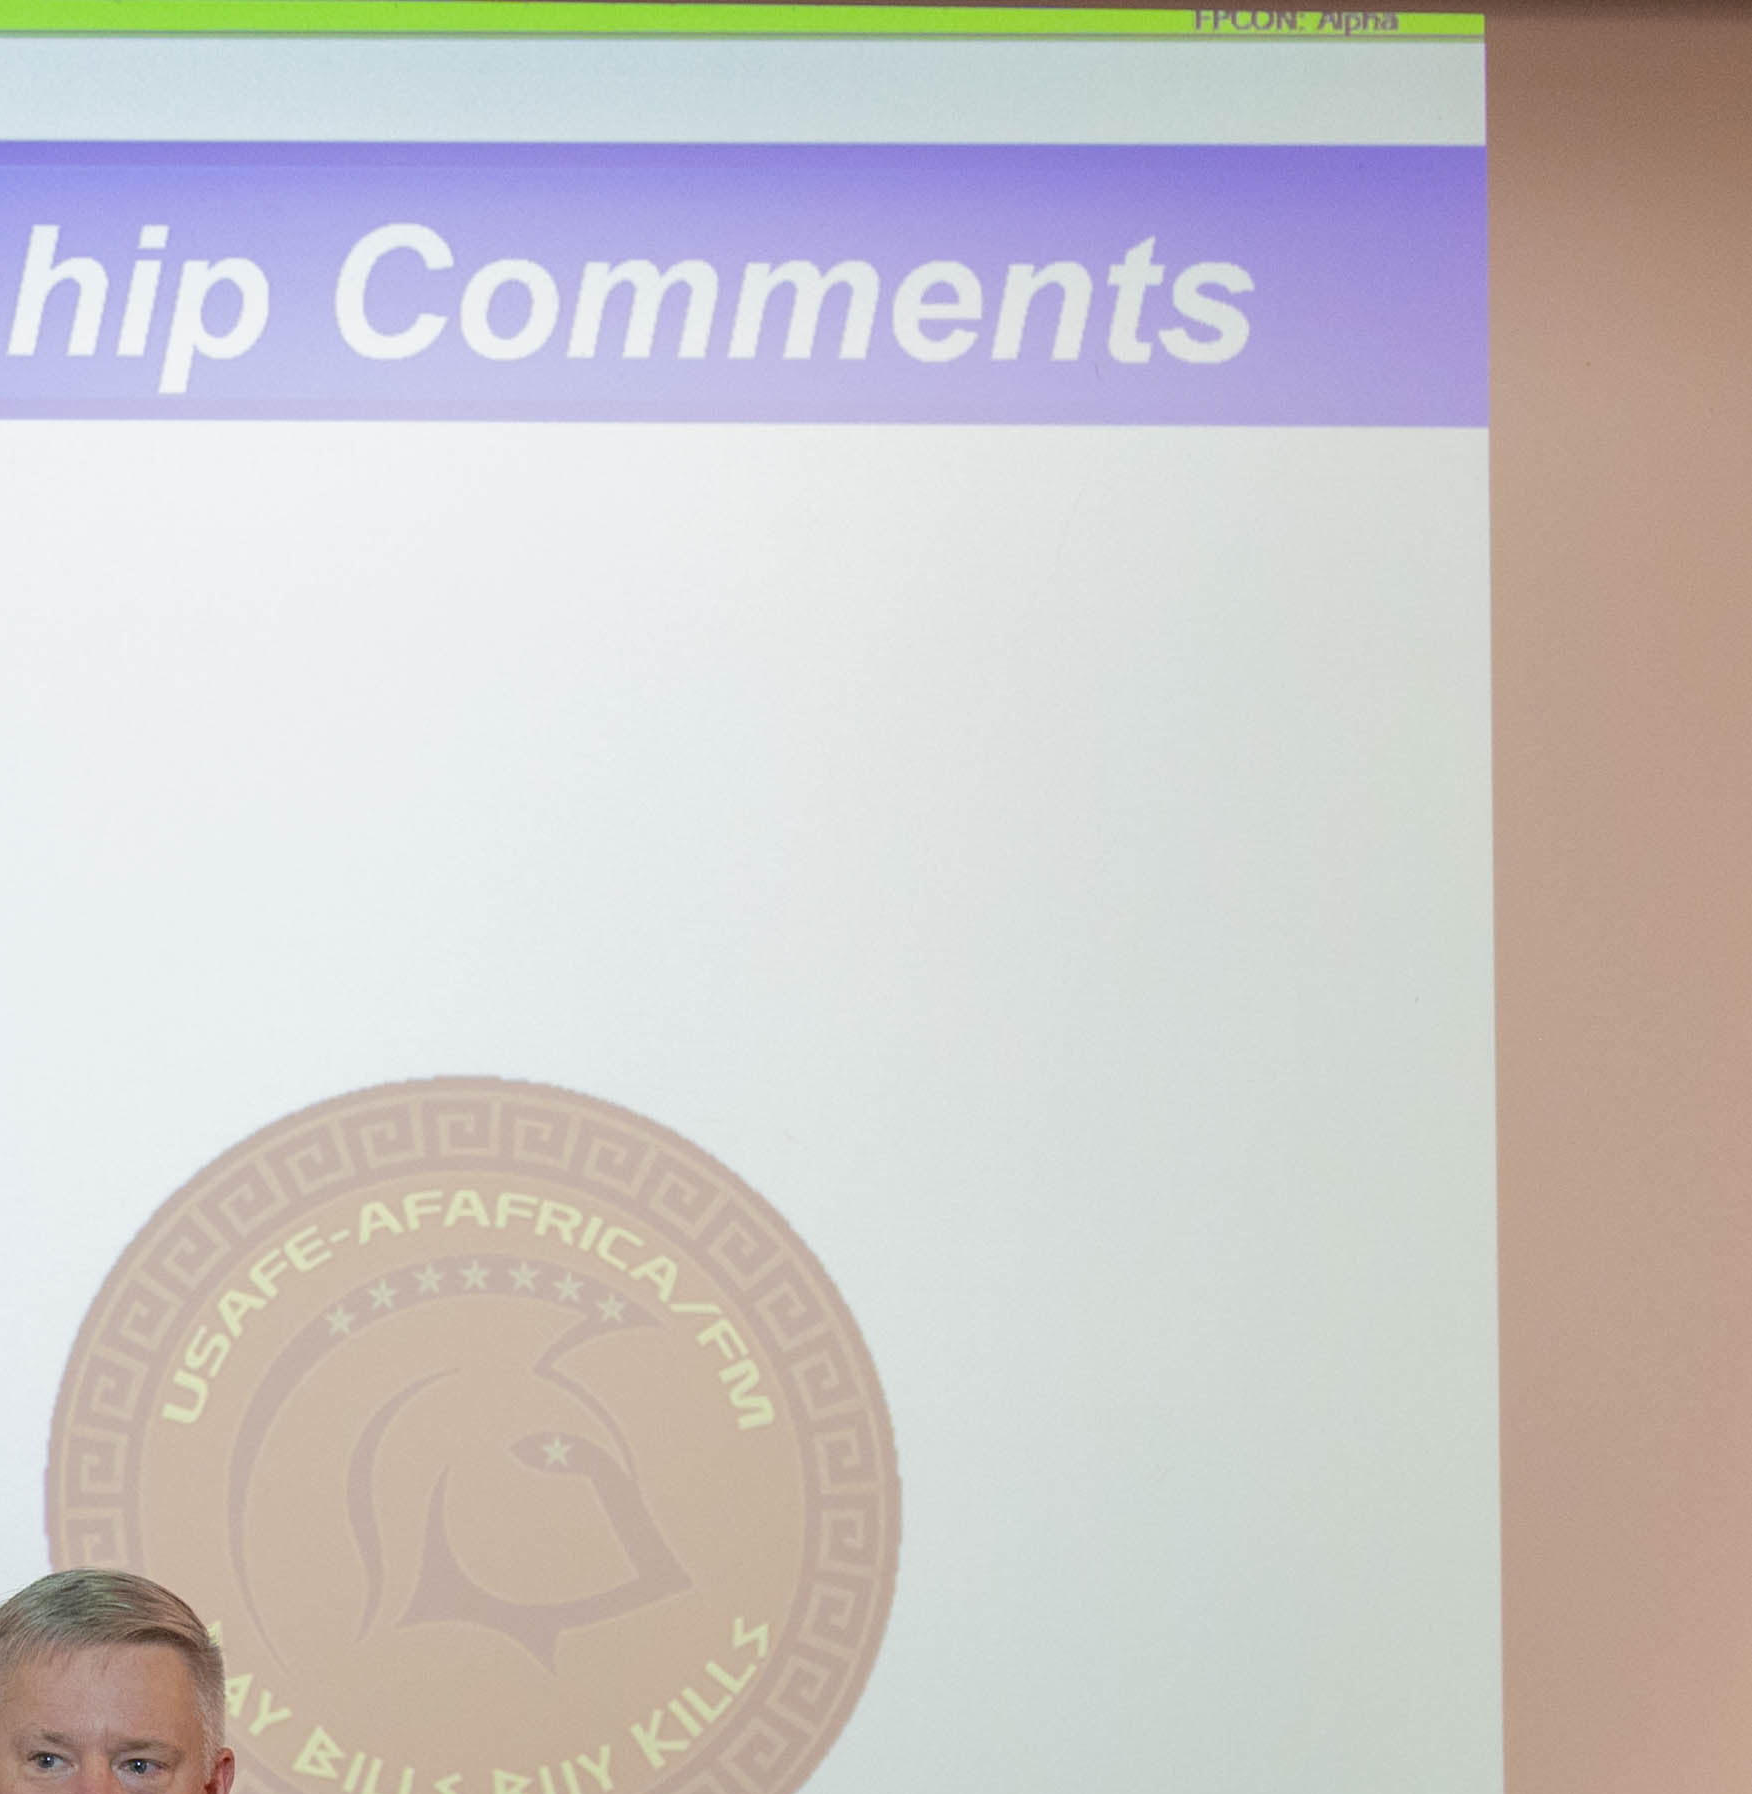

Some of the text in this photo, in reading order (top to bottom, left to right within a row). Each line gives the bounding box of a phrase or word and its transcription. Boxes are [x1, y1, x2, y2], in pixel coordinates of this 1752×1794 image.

[1194, 9, 1400, 36] FPCON: Alpha
[333, 224, 1258, 366] Comments
[162, 1188, 776, 1430] USAFE-AFAFRICA/FM
[630, 1616, 770, 1770] KILLS
